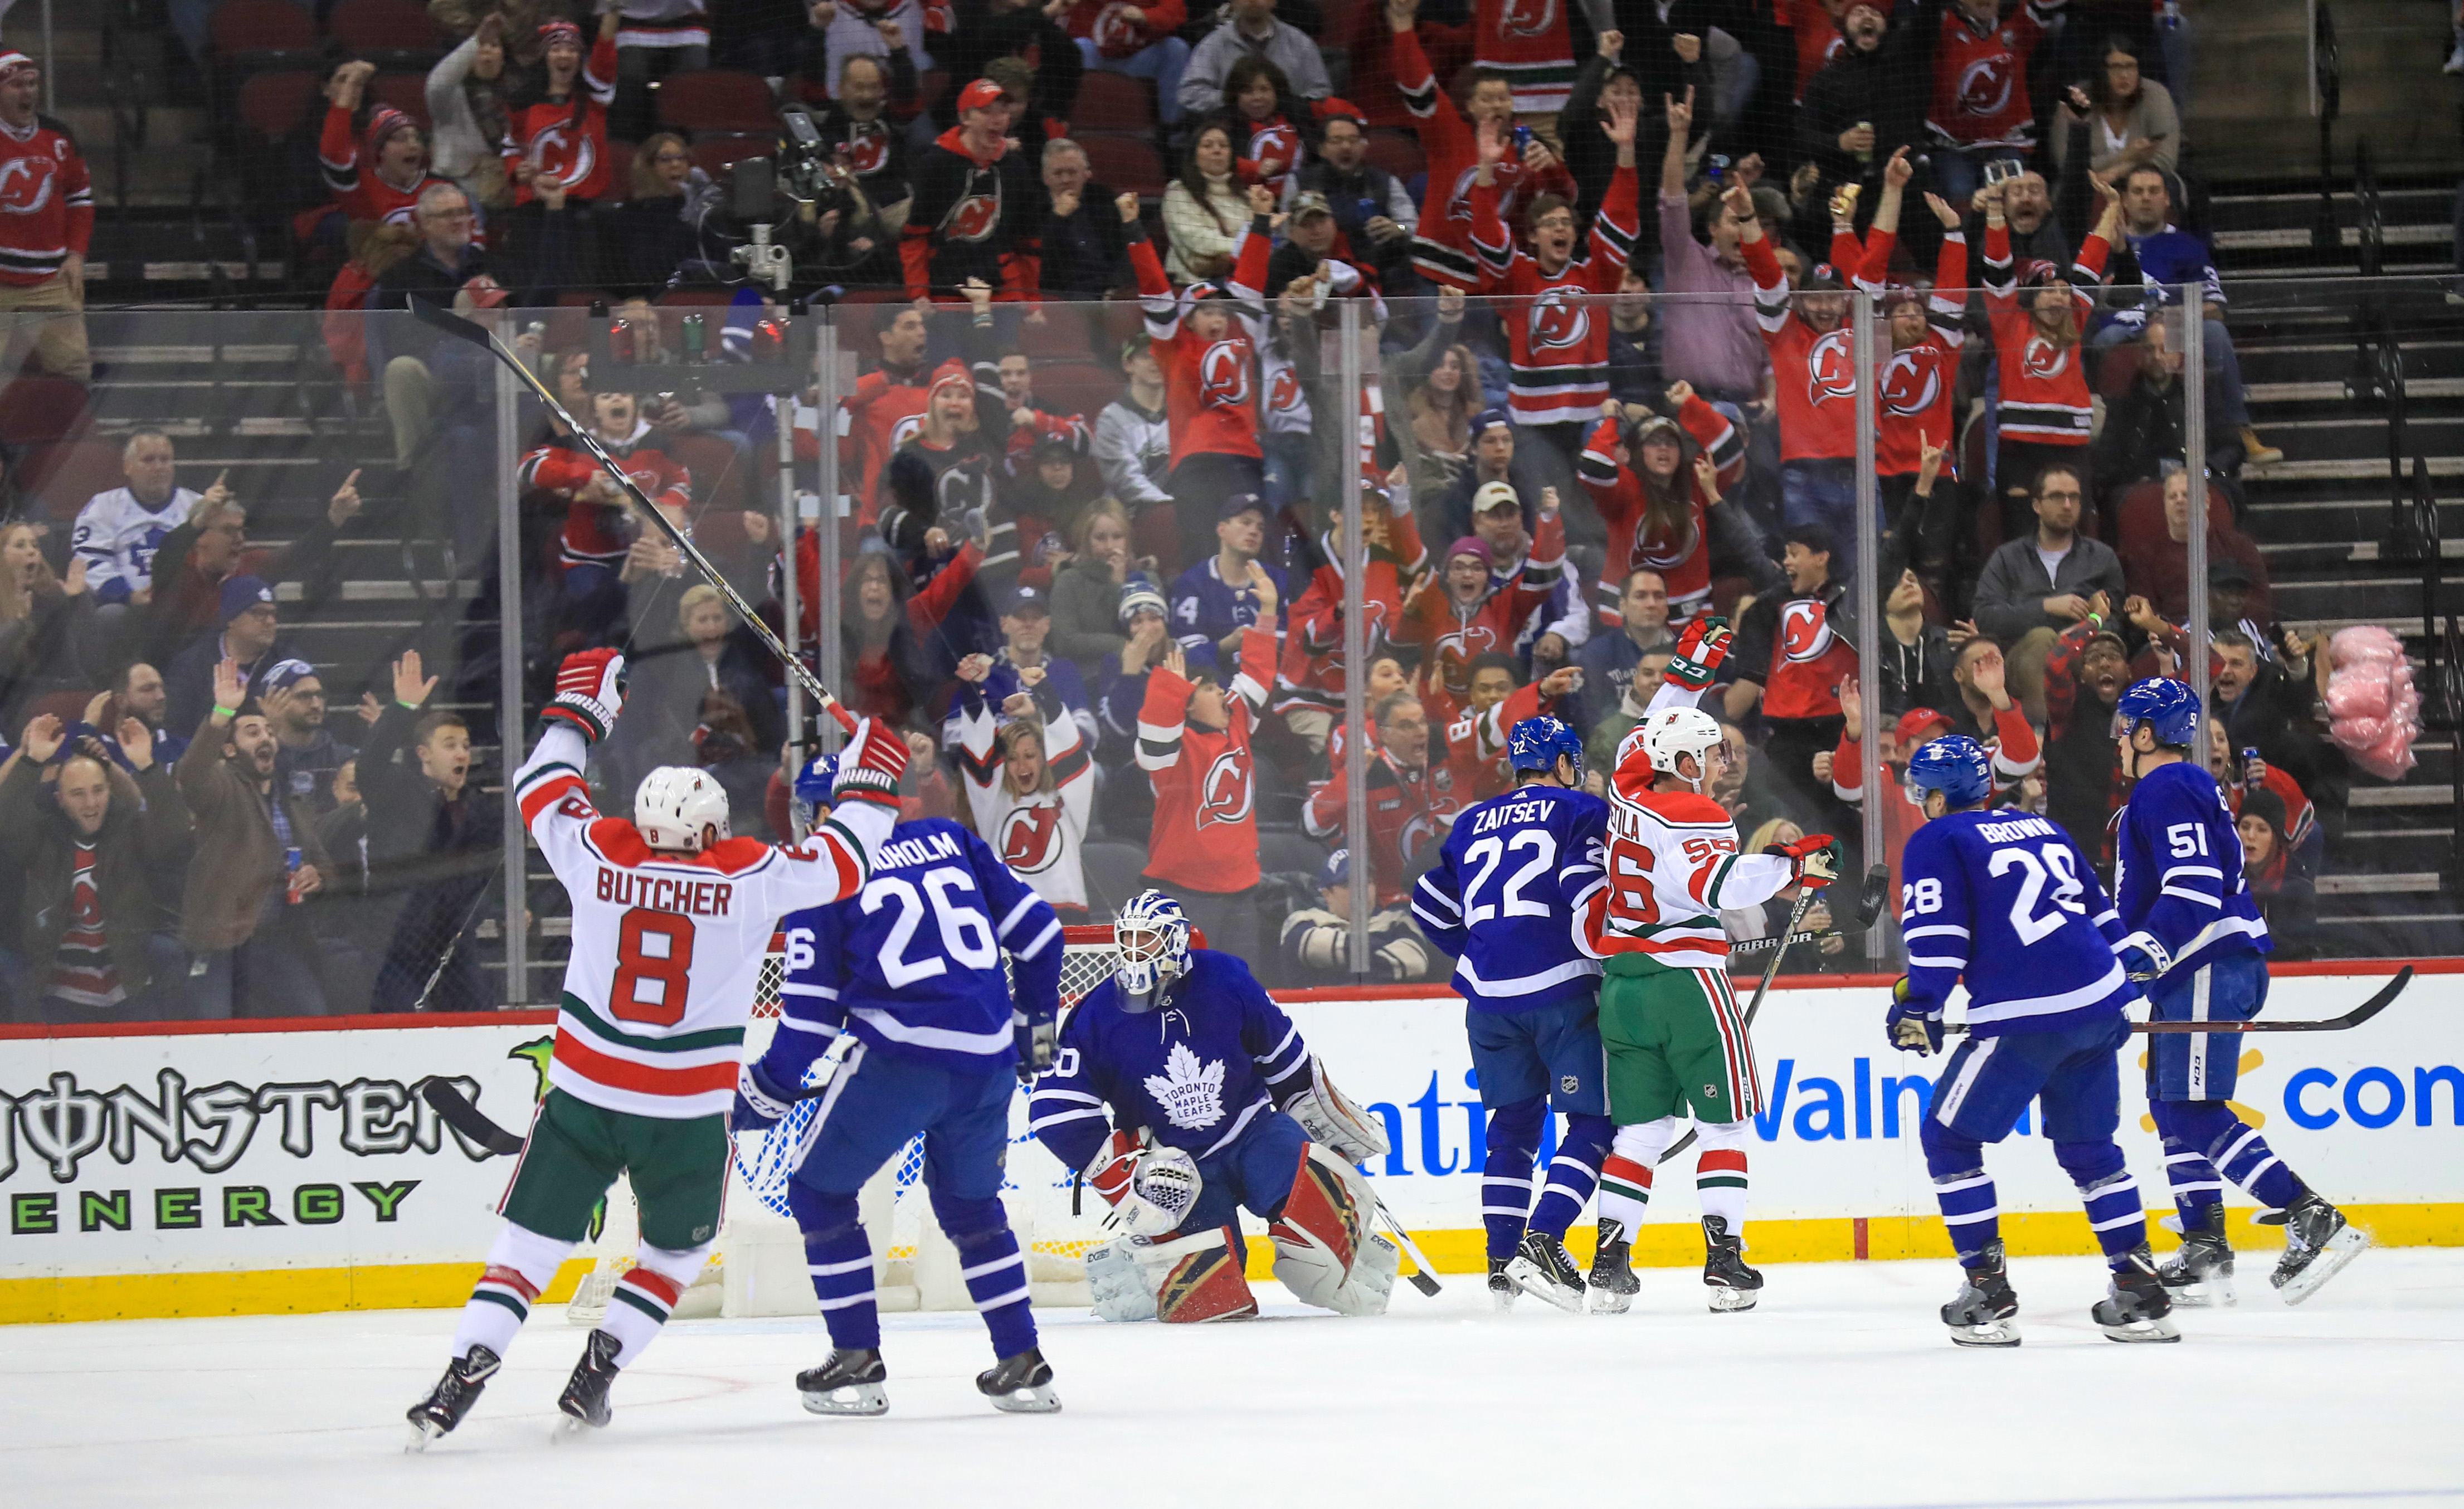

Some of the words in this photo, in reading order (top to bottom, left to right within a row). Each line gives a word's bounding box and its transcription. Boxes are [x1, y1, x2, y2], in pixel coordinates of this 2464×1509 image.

[1976, 763, 1988, 776] 28
[650, 829, 660, 844] 8
[1472, 800, 1556, 836] ZAITSEV
[1974, 817, 2058, 844] BROWN
[2166, 822, 2209, 859] 51
[597, 865, 733, 916] BUTCHER
[1463, 829, 1557, 931] 22
[1987, 843, 2087, 947] 28
[1794, 898, 1809, 923] CCM
[1901, 877, 1943, 925] 28
[859, 865, 999, 990] 26
[608, 906, 697, 1028] 8
[741, 1078, 785, 1115] CCM
[1164, 1081, 1215, 1102] TORONTO
[1175, 1093, 1210, 1109] MAPLE
[1177, 1103, 1212, 1118] LEAFS
[11, 1180, 422, 1235] ENERGY
